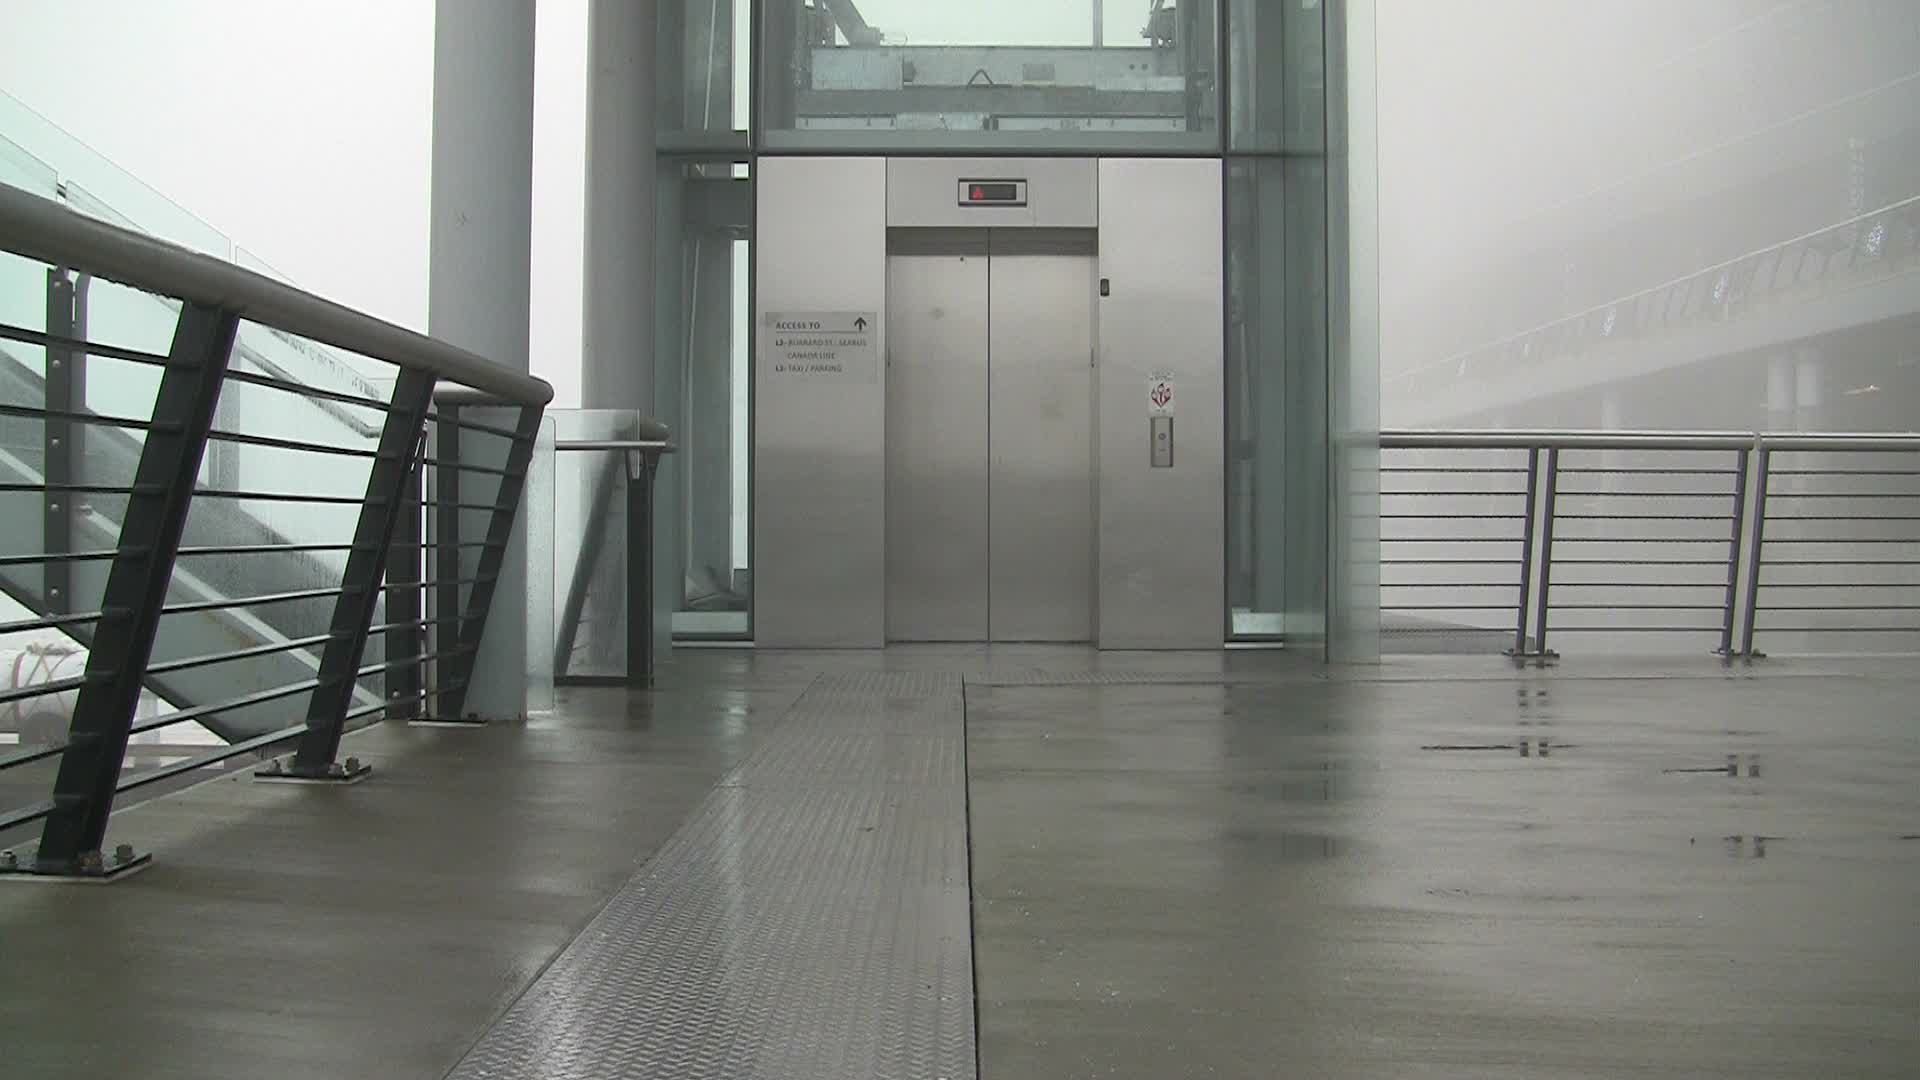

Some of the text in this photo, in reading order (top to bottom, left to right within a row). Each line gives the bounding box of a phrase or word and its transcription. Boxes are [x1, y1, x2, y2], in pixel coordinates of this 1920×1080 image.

[775, 321, 821, 330] ACCESS TO
[818, 351, 835, 360] LINE
[809, 364, 842, 373] PARKING
